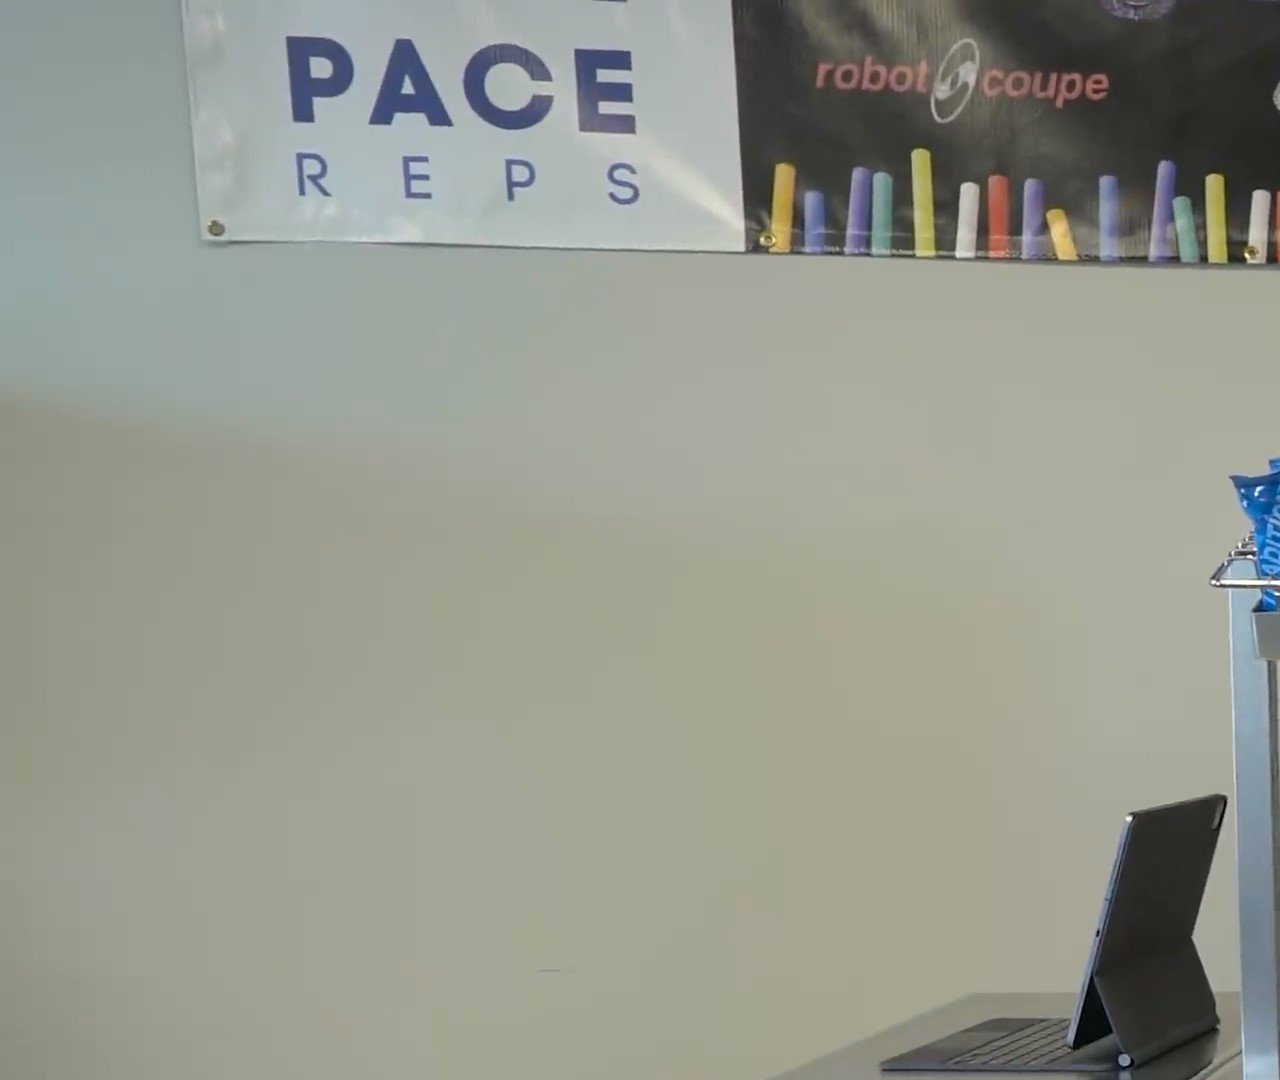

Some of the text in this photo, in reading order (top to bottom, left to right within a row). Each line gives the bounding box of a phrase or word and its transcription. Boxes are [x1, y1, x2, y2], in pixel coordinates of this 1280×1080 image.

[286, 36, 637, 135] PACE
[815, 56, 1110, 109] robot coupe
[296, 152, 641, 205] REPS
